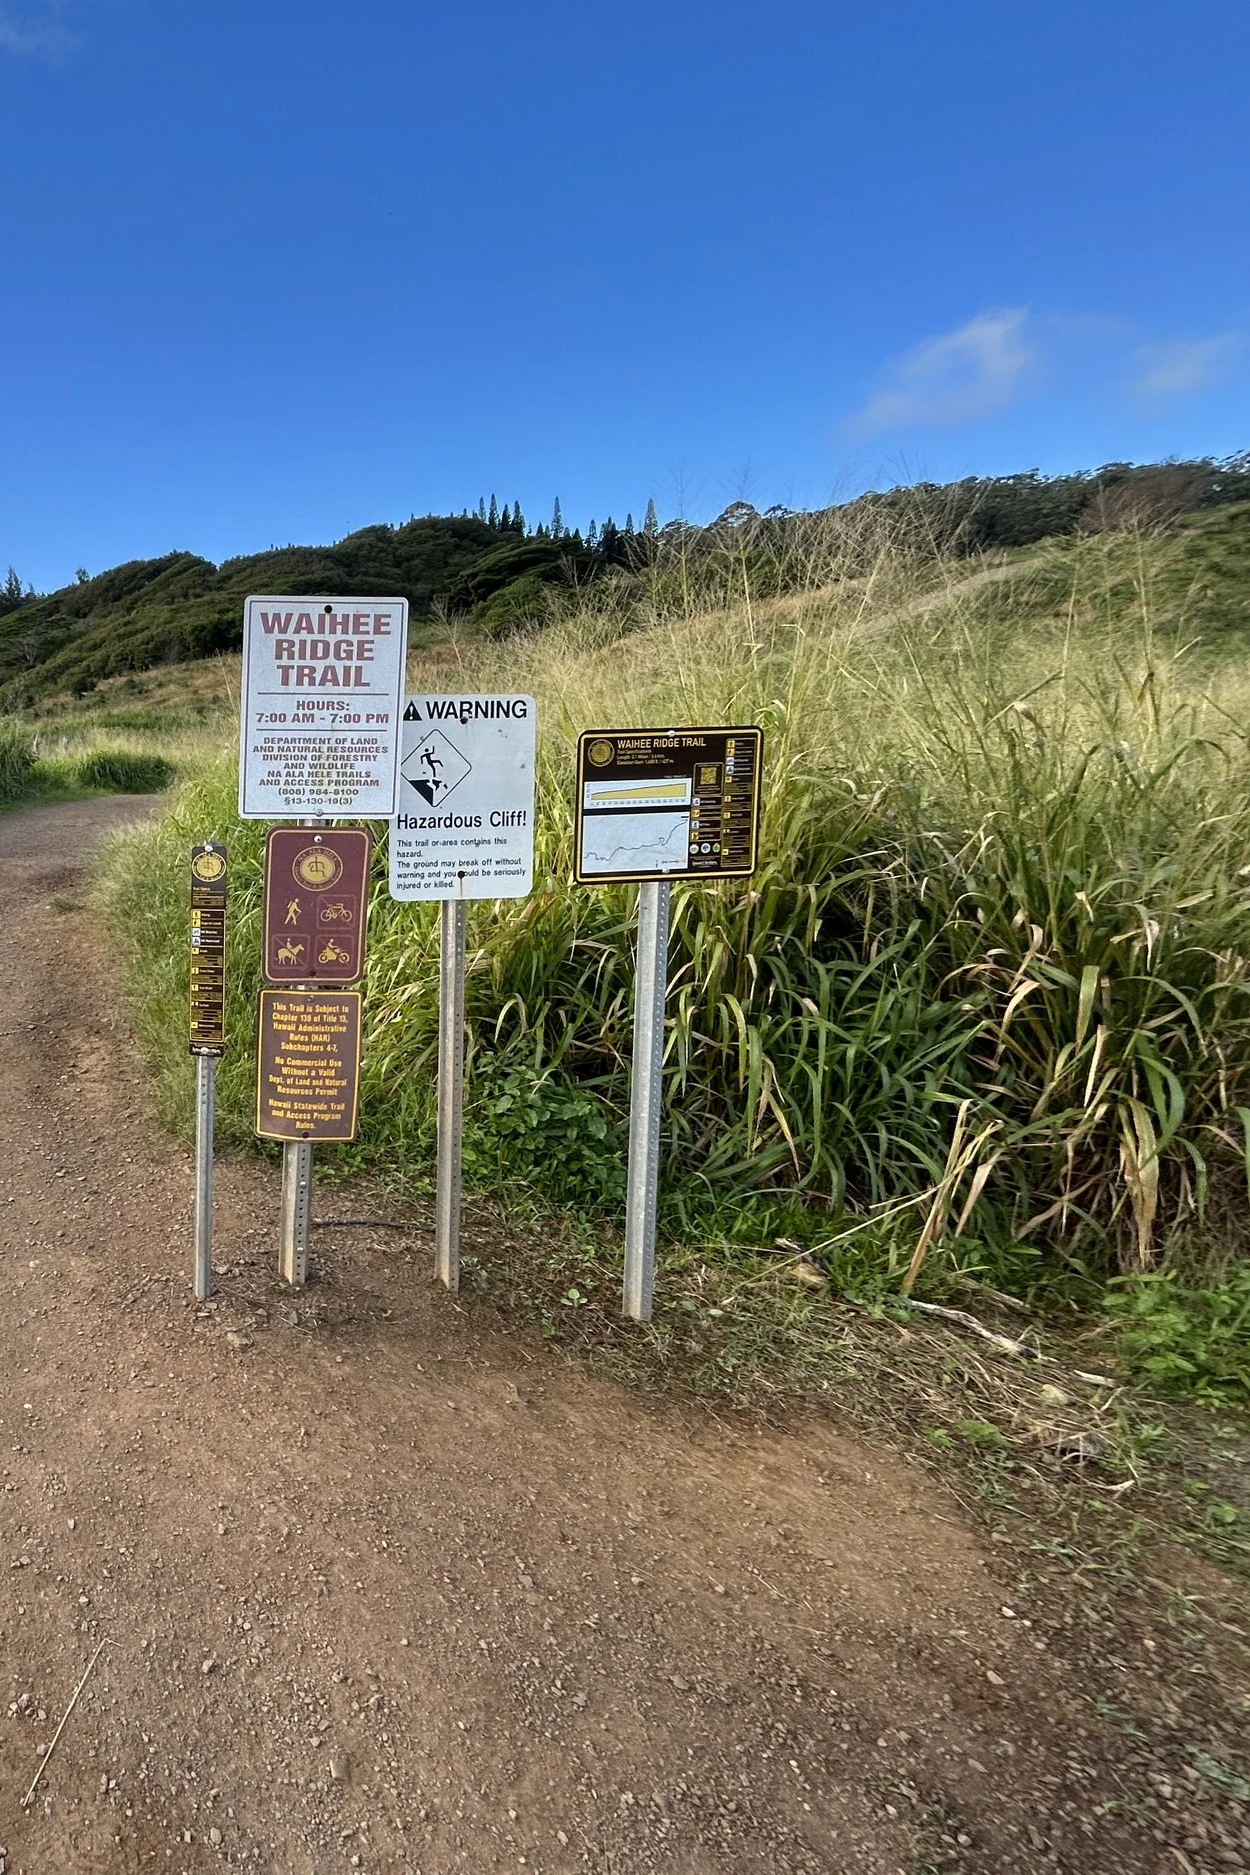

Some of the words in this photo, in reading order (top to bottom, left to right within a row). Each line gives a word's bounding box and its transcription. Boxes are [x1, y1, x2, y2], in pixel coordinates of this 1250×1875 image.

[260, 612, 391, 635] WAIHEE
[275, 639, 374, 661] RIDGE
[277, 665, 370, 687] TRAIL
[296, 701, 350, 710] HOURS:
[426, 700, 527, 719] WARNING
[256, 713, 286, 723] 7:00
[291, 713, 314, 723] AM
[330, 714, 361, 723] 7:00
[366, 714, 388, 723] PM
[617, 739, 651, 748] WAIHEE
[653, 739, 680, 748] RIDGE
[682, 738, 707, 747] TRAIL
[397, 812, 482, 829] Hazardous
[490, 810, 526, 827] Cliff!
[414, 860, 438, 869] ground
[397, 871, 424, 879] warning
[458, 870, 478, 879] ould
[397, 882, 421, 890] injured
[273, 1003, 286, 1011] This
[315, 1005, 339, 1013] Subject
[272, 1013, 297, 1021] Chapter
[273, 1022, 295, 1030] Hawaii
[281, 1042, 323, 1052] Subchapters
[287, 1058, 326, 1066] Commercial
[282, 1067, 308, 1076] Without
[269, 1075, 284, 1084] Dept.
[277, 1086, 312, 1095] Resources
[269, 1099, 291, 1108] Hawaii
[294, 1102, 327, 1110] Statewide
[314, 1113, 341, 1121] Program
